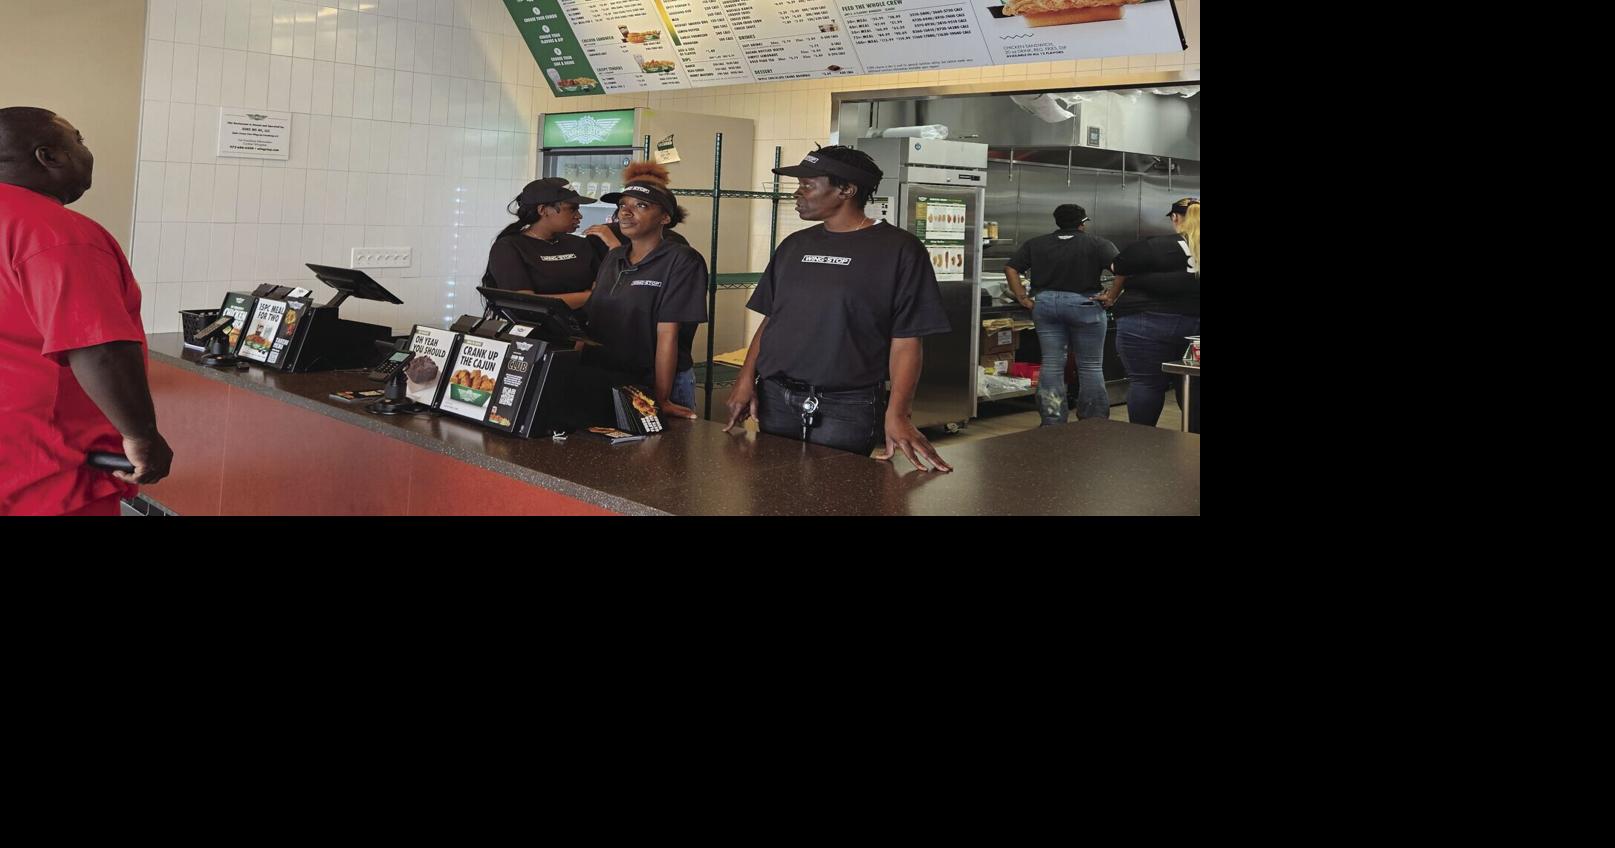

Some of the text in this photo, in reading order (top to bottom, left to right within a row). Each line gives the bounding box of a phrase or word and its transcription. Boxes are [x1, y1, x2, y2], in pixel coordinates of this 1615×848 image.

[271, 305, 284, 314] MEAL
[258, 312, 280, 322] FOR TWO
[424, 337, 440, 347] YEAH
[414, 344, 446, 358] YOU SHOULD
[463, 346, 498, 361] CRANK UP
[460, 356, 496, 372] THE CAJUN
[508, 360, 528, 372] CLUB
